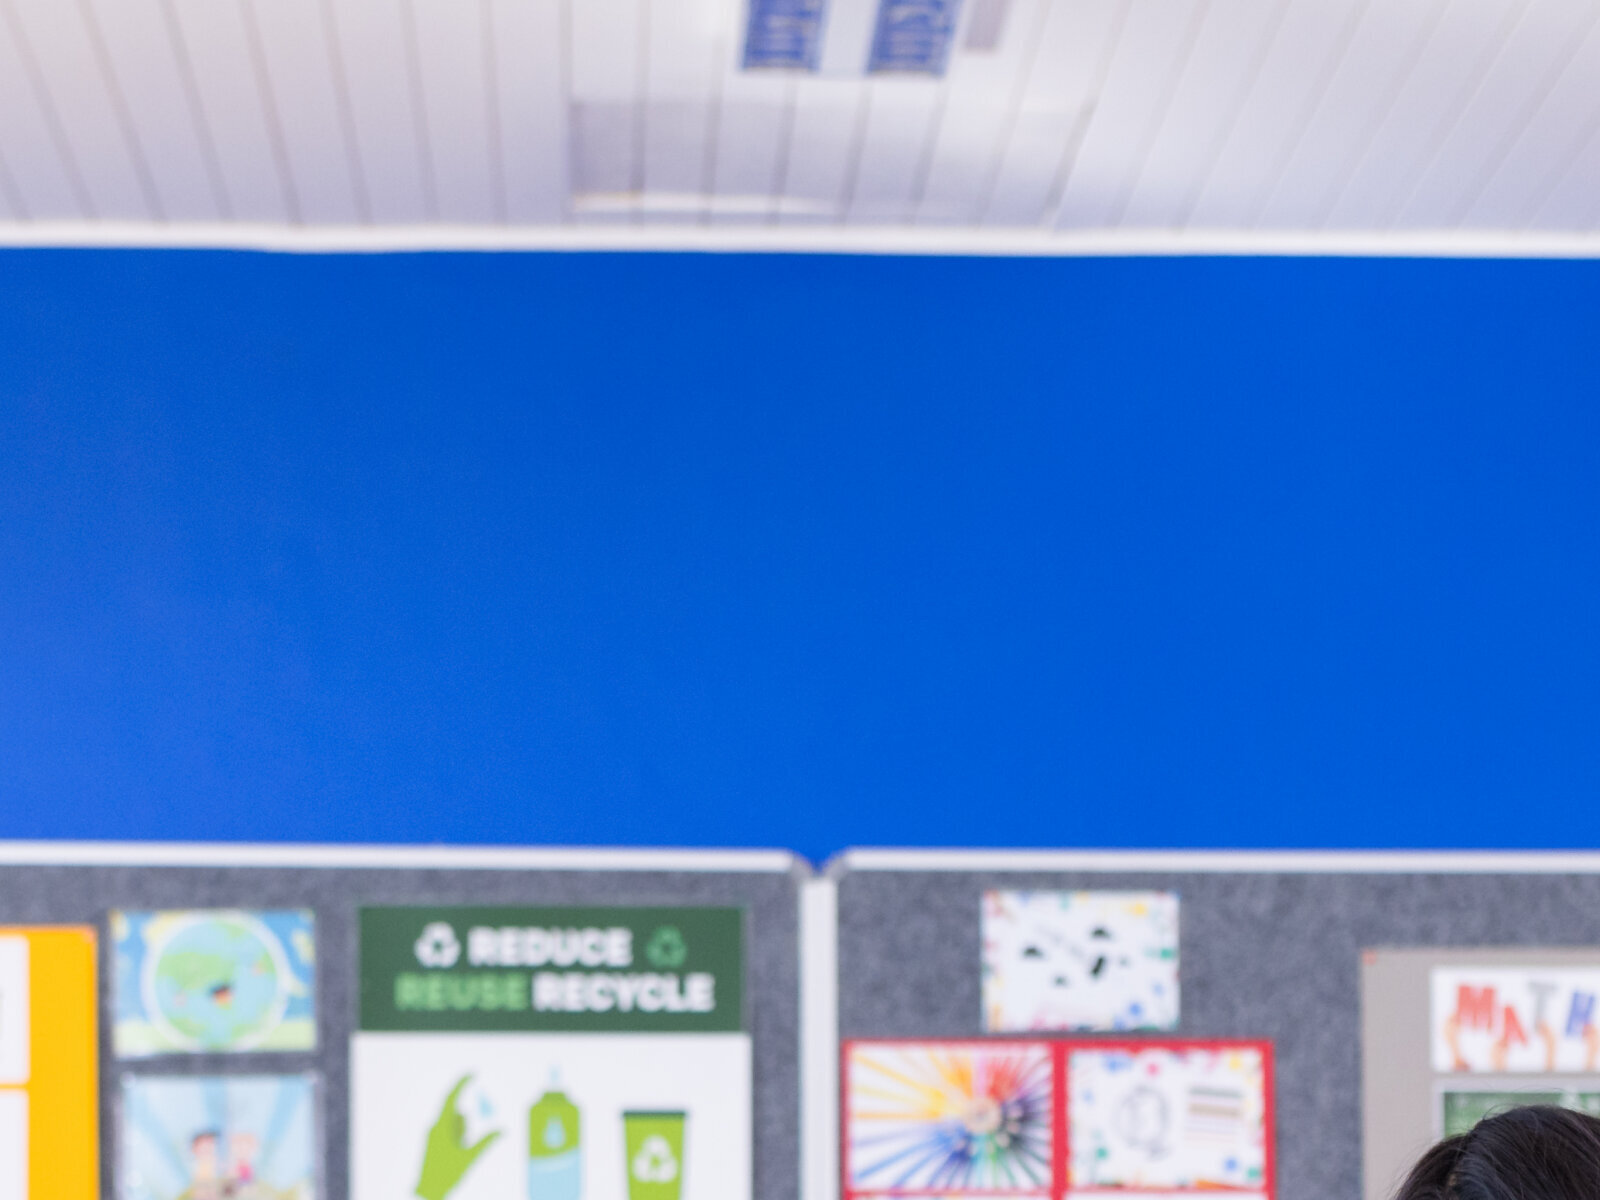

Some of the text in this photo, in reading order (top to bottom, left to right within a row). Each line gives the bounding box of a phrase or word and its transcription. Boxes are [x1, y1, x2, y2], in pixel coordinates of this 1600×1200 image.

[466, 926, 633, 967] REDUCE
[395, 972, 716, 1012] REUSE RECYCLE
[1453, 981, 1600, 1046] MATH
